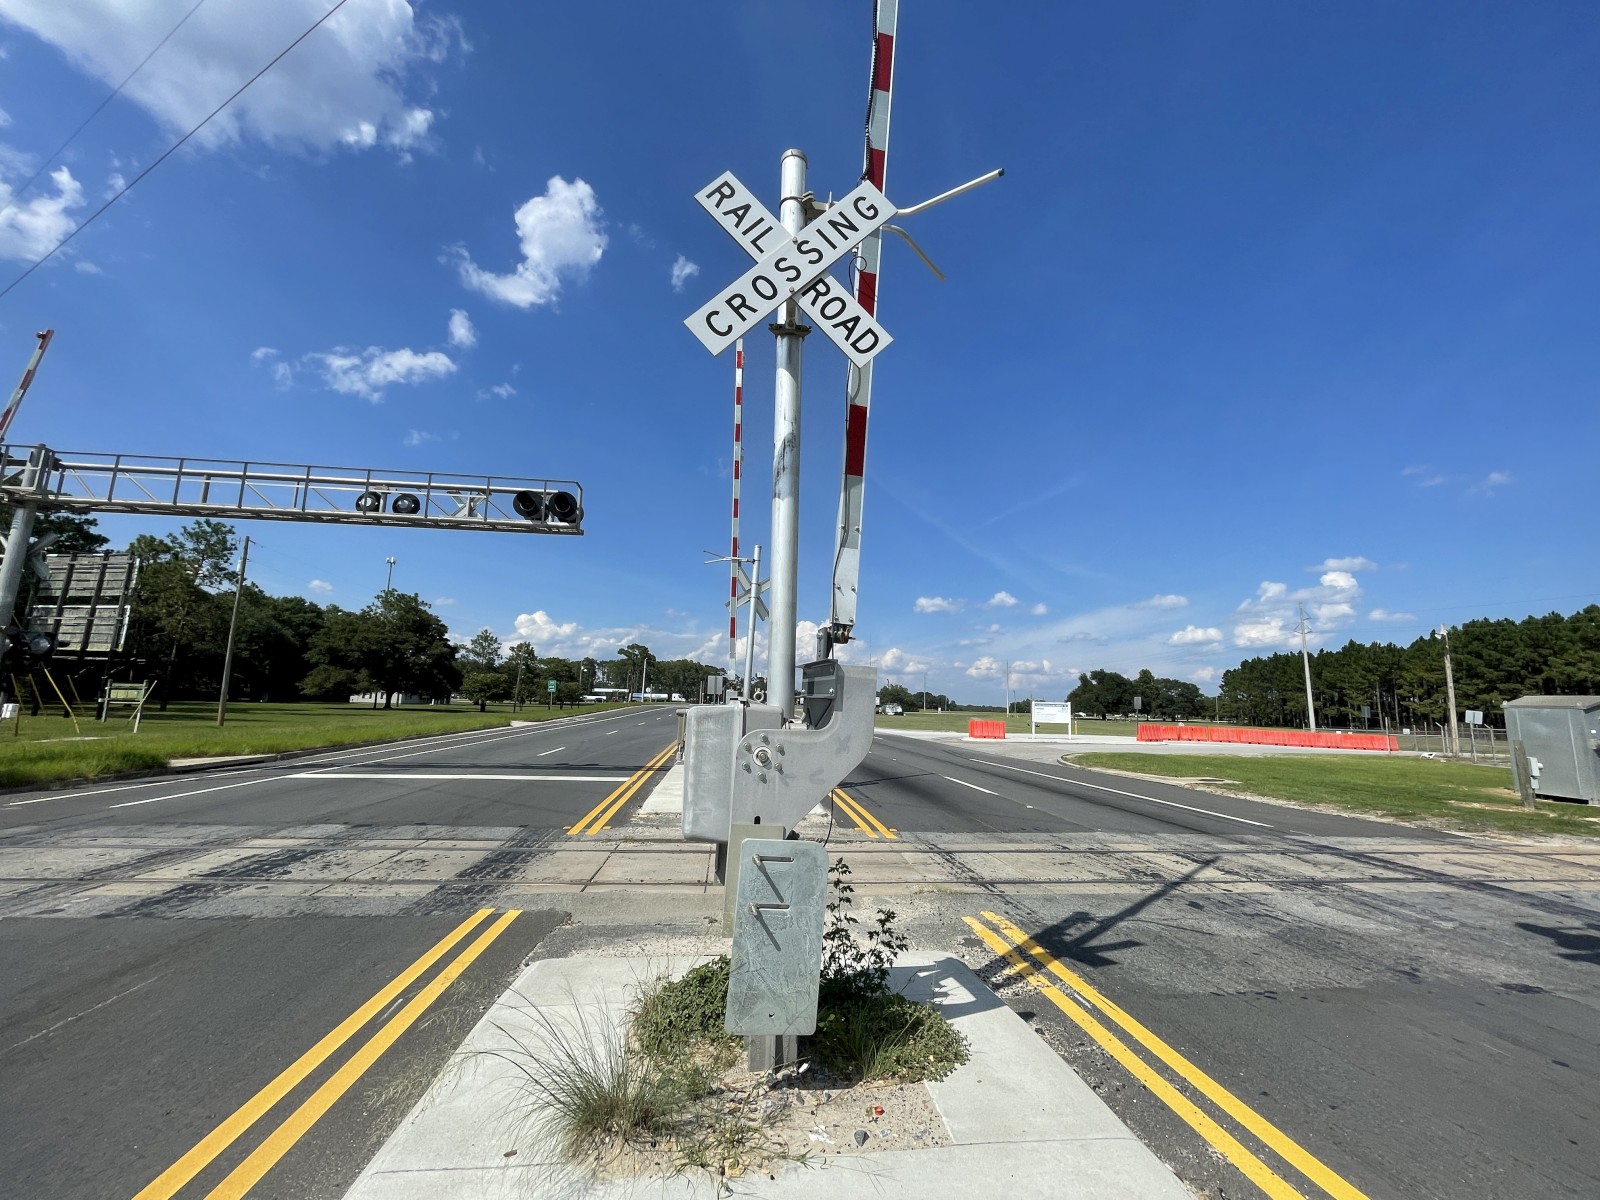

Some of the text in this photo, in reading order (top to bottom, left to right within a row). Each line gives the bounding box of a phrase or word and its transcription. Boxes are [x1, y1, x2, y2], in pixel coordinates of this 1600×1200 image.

[705, 196, 879, 337] CROSSING
[705, 180, 879, 354] RAIL ROAD
